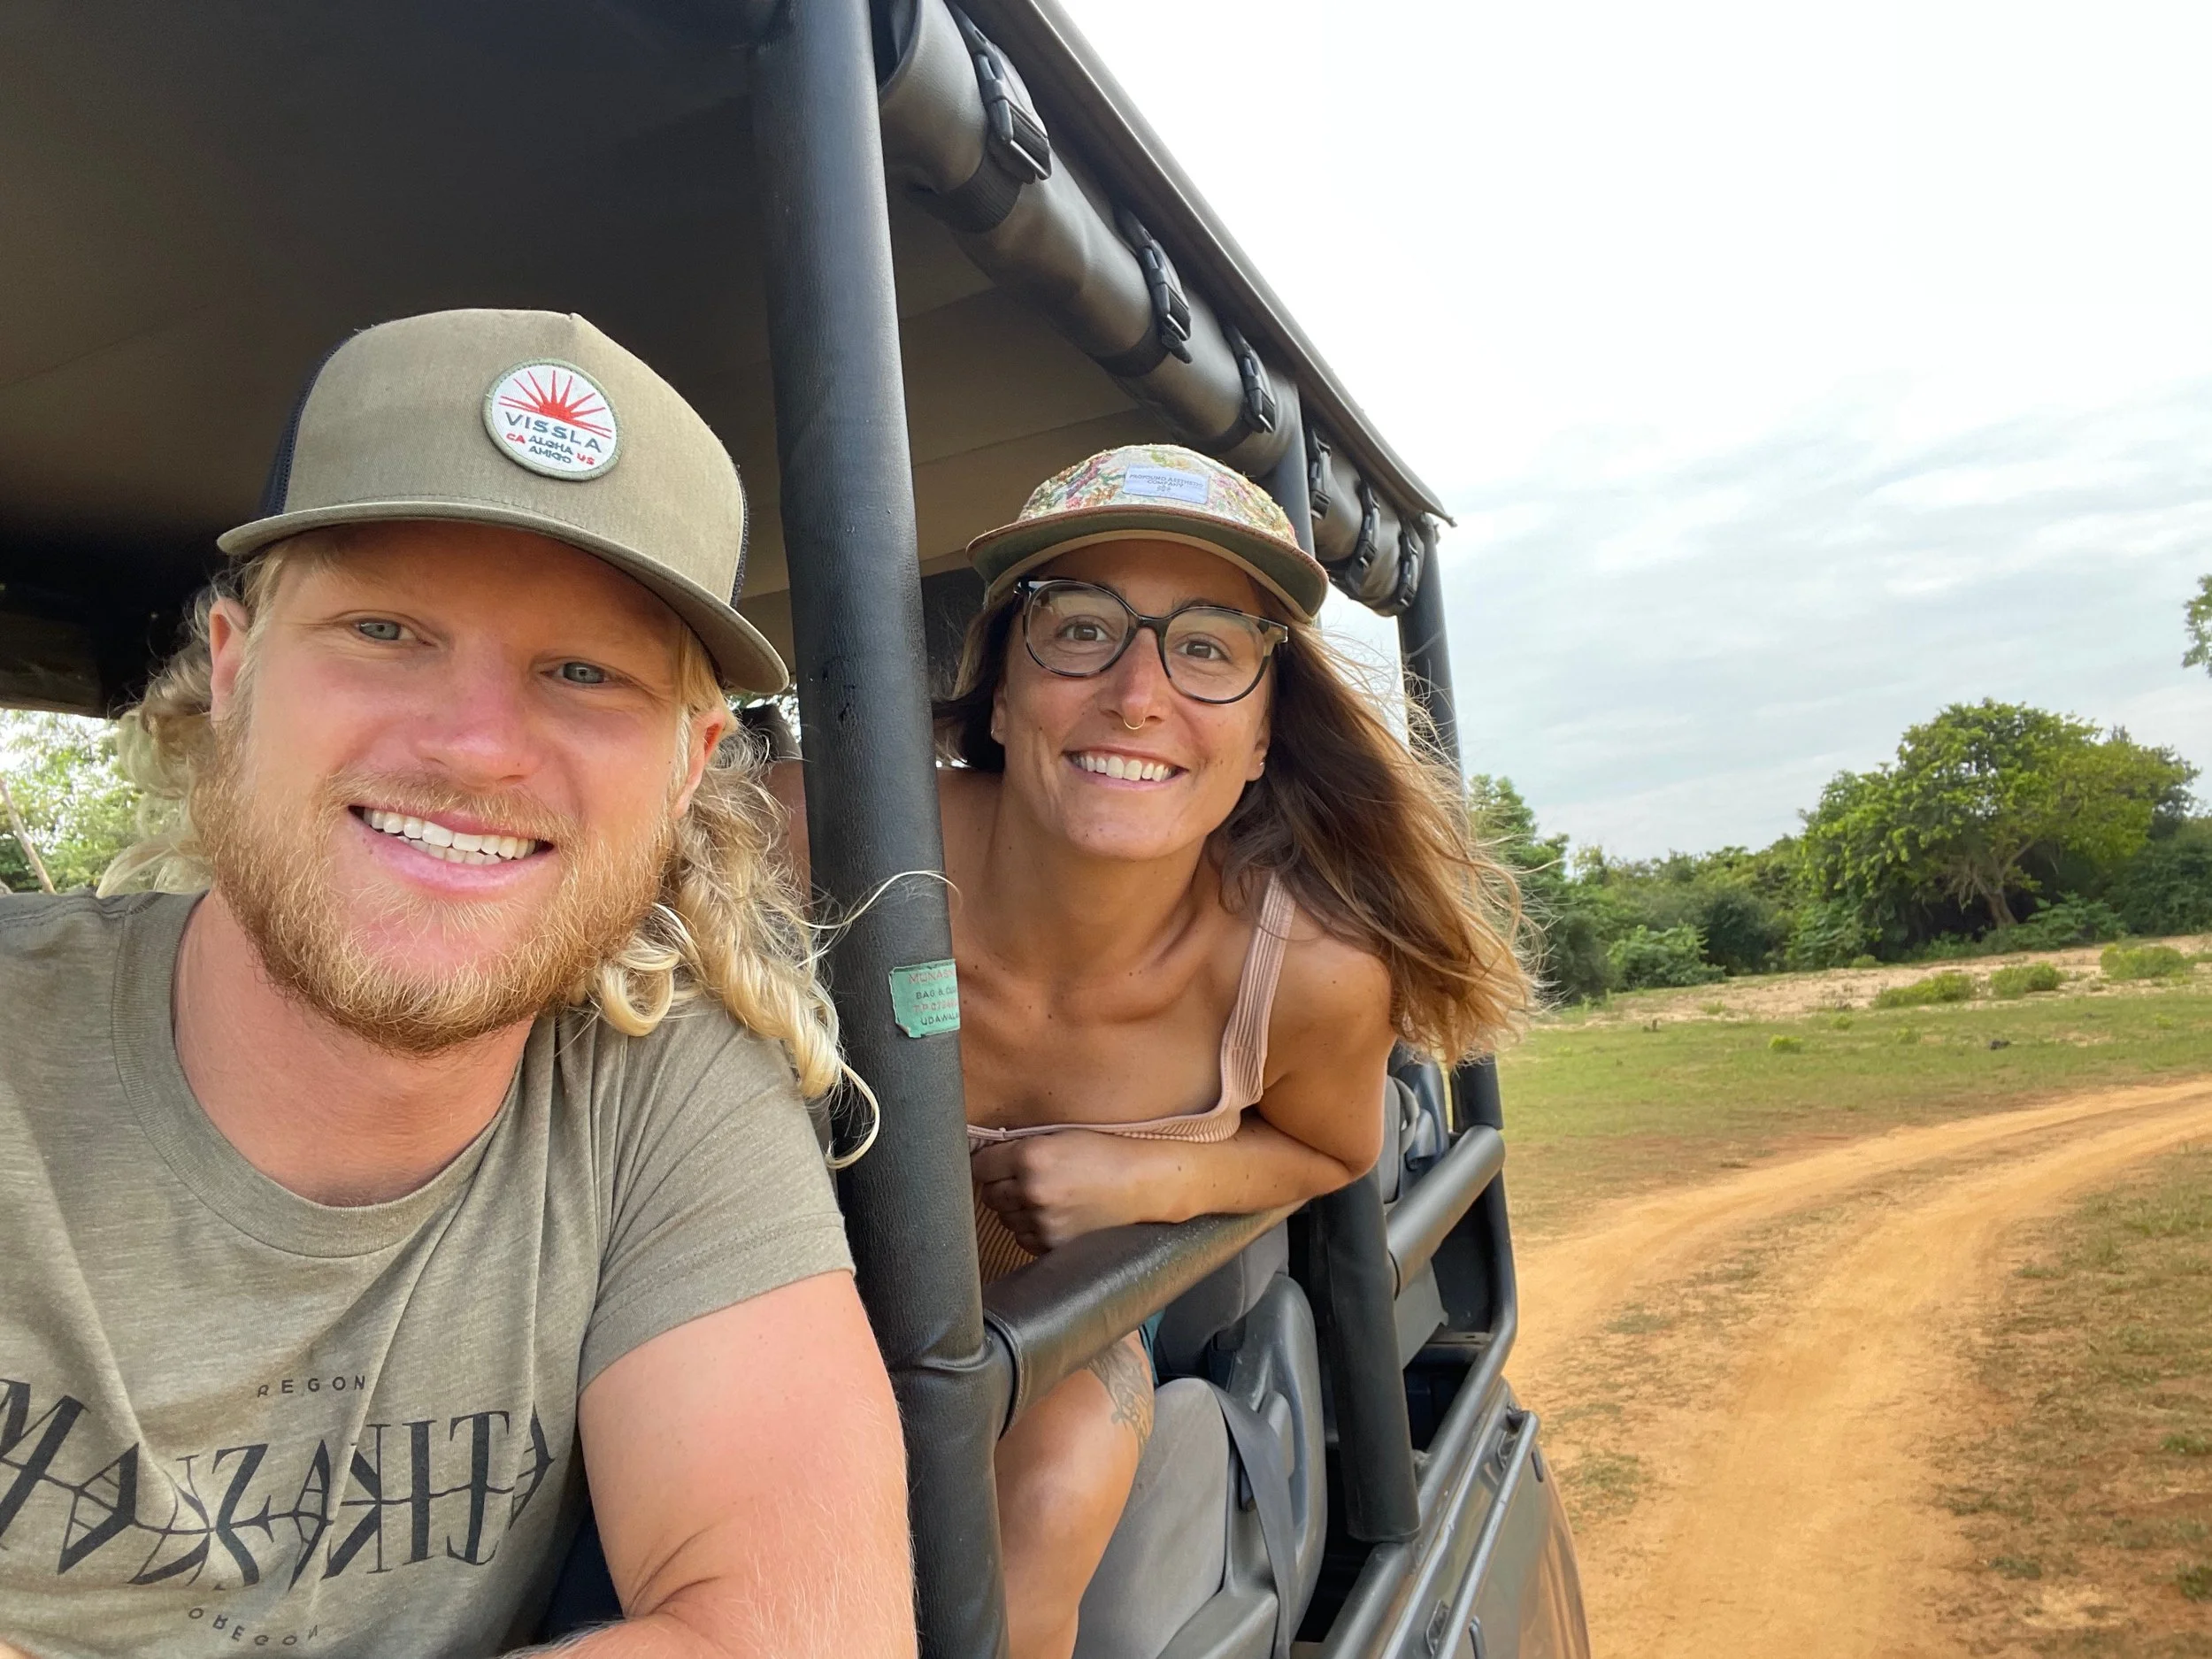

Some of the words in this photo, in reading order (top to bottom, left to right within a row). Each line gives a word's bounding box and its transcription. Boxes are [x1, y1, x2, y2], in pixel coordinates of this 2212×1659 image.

[505, 411, 602, 453] VISSLA
[506, 433, 526, 444] CA
[528, 435, 574, 456] ALOHA
[528, 445, 572, 464] AMIGO
[577, 452, 595, 465] US
[916, 989, 935, 1000] BAG
